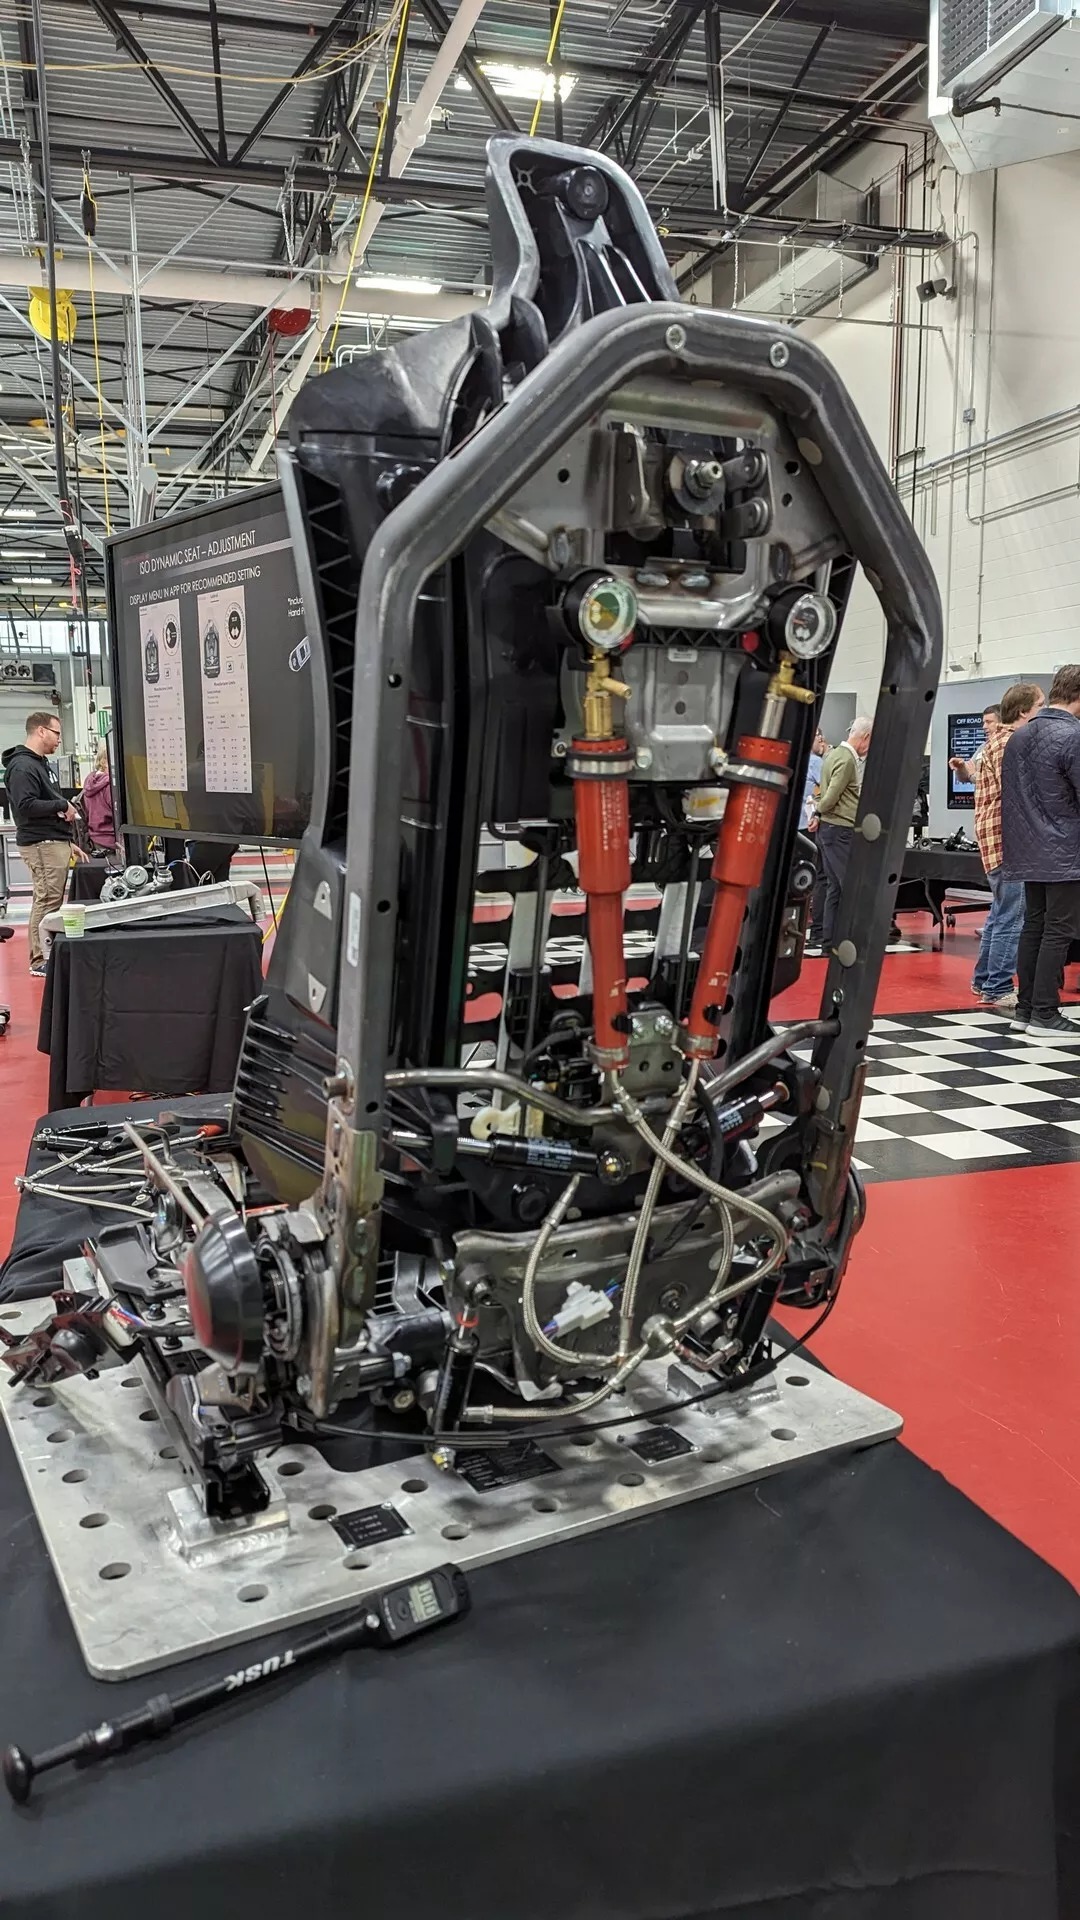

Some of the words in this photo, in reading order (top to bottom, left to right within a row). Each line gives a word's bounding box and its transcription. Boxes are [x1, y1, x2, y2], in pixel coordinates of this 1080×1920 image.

[139, 560, 150, 575] ISO
[151, 551, 183, 572] DYNAMIC
[184, 545, 200, 563] SEAT
[208, 530, 255, 557] ADJUSTMENT
[130, 591, 148, 605] DISPLAY
[149, 589, 162, 602] MENU
[164, 587, 169, 598] IN
[170, 585, 179, 597] APP
[180, 582, 191, 594] FOR
[192, 571, 236, 591] RECOMMENDED
[237, 565, 260, 582] SETTING
[223, 1649, 297, 1692] TUSK
